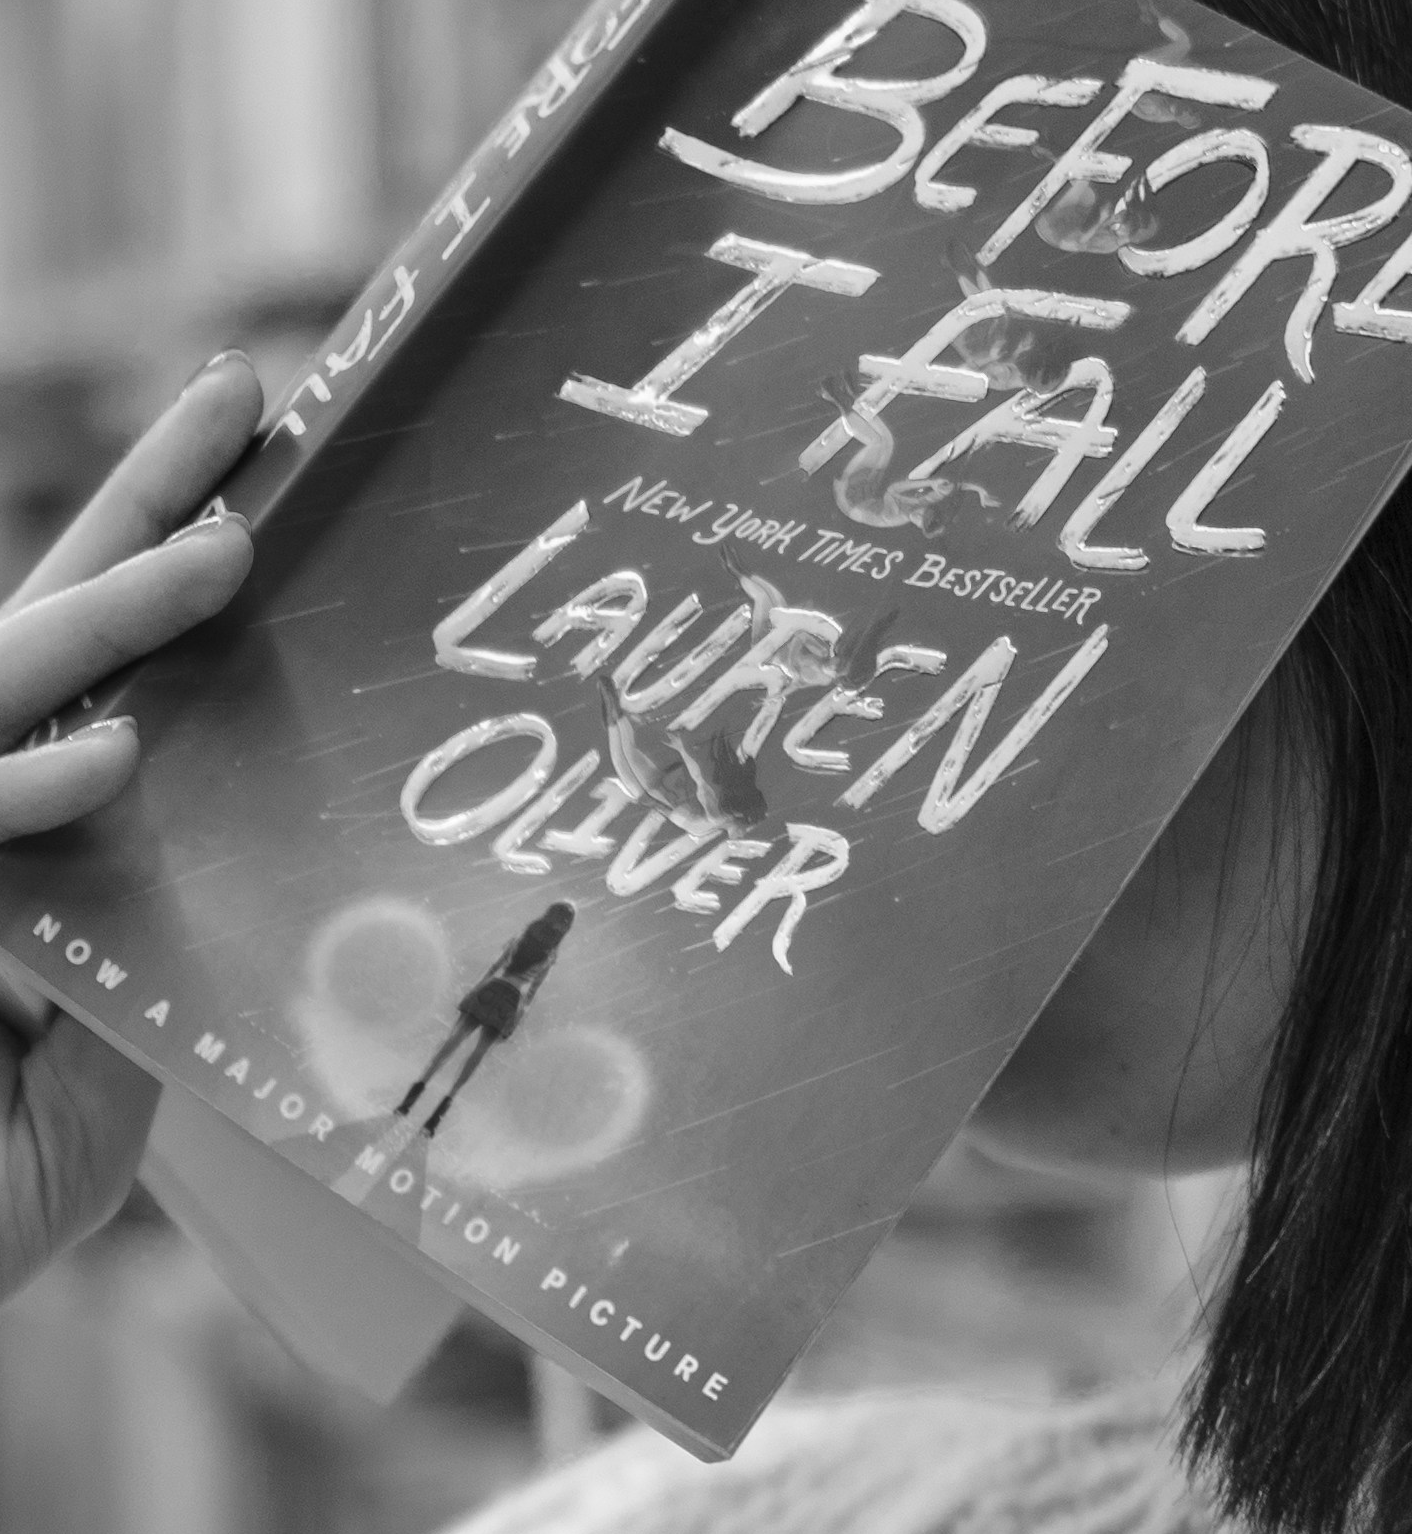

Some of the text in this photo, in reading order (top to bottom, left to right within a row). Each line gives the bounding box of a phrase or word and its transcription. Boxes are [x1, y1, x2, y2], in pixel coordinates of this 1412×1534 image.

[434, 170, 492, 261] I
[260, 265, 420, 452] FALL
[558, 230, 1288, 573] I FALL
[432, 500, 1109, 835] LAUREN
[602, 475, 1102, 626] NEW YORK TIMES BESTSELLER
[399, 713, 850, 975] OLIVER
[32, 913, 730, 1403] NOW A MAJOR MOTION PICTURE
